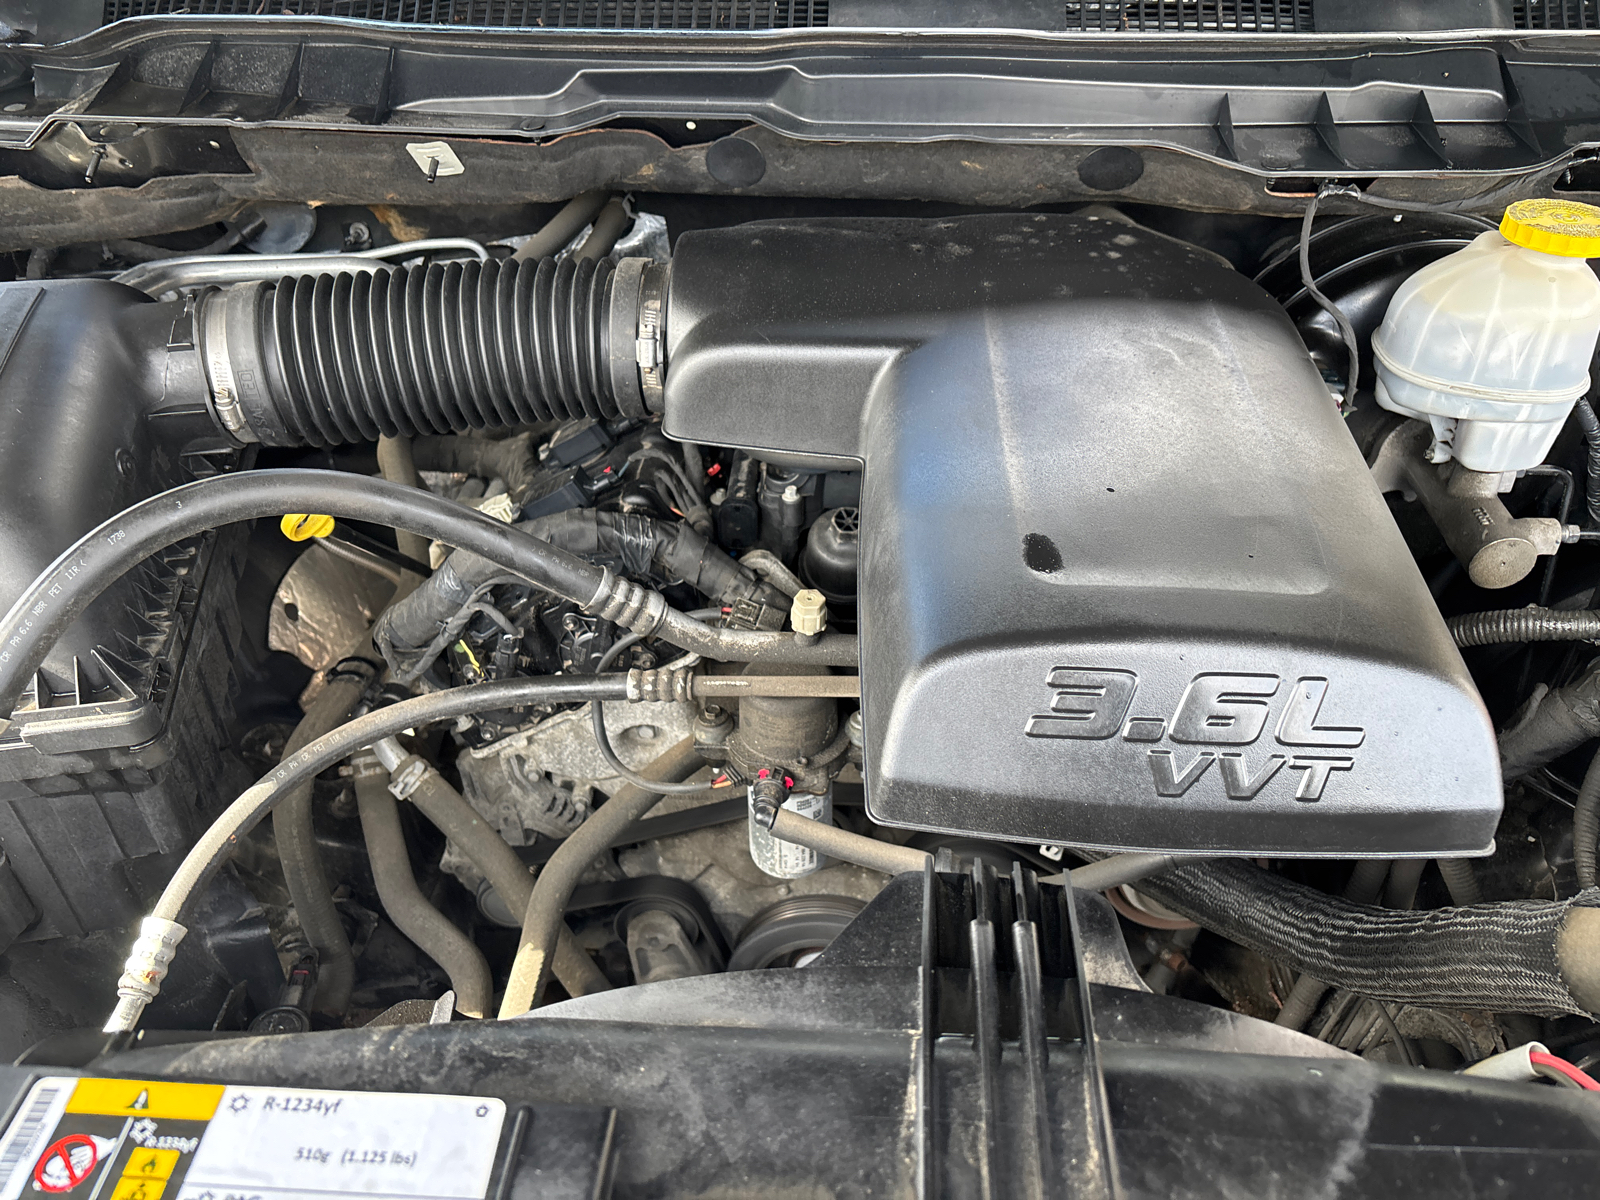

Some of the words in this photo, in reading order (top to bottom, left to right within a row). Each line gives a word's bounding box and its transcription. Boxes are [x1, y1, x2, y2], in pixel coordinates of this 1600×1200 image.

[0, 650, 12, 663] CR
[9, 635, 22, 648] PA
[18, 619, 33, 635] 6.6
[31, 600, 48, 616] NBR
[48, 582, 63, 598] PET
[64, 565, 81, 580] IIR
[107, 529, 126, 546] 1738
[1024, 664, 1366, 749] 3.6L
[1147, 749, 1355, 802] VVT
[262, 1096, 343, 1117] R-1234yf
[294, 1147, 330, 1164] 510g
